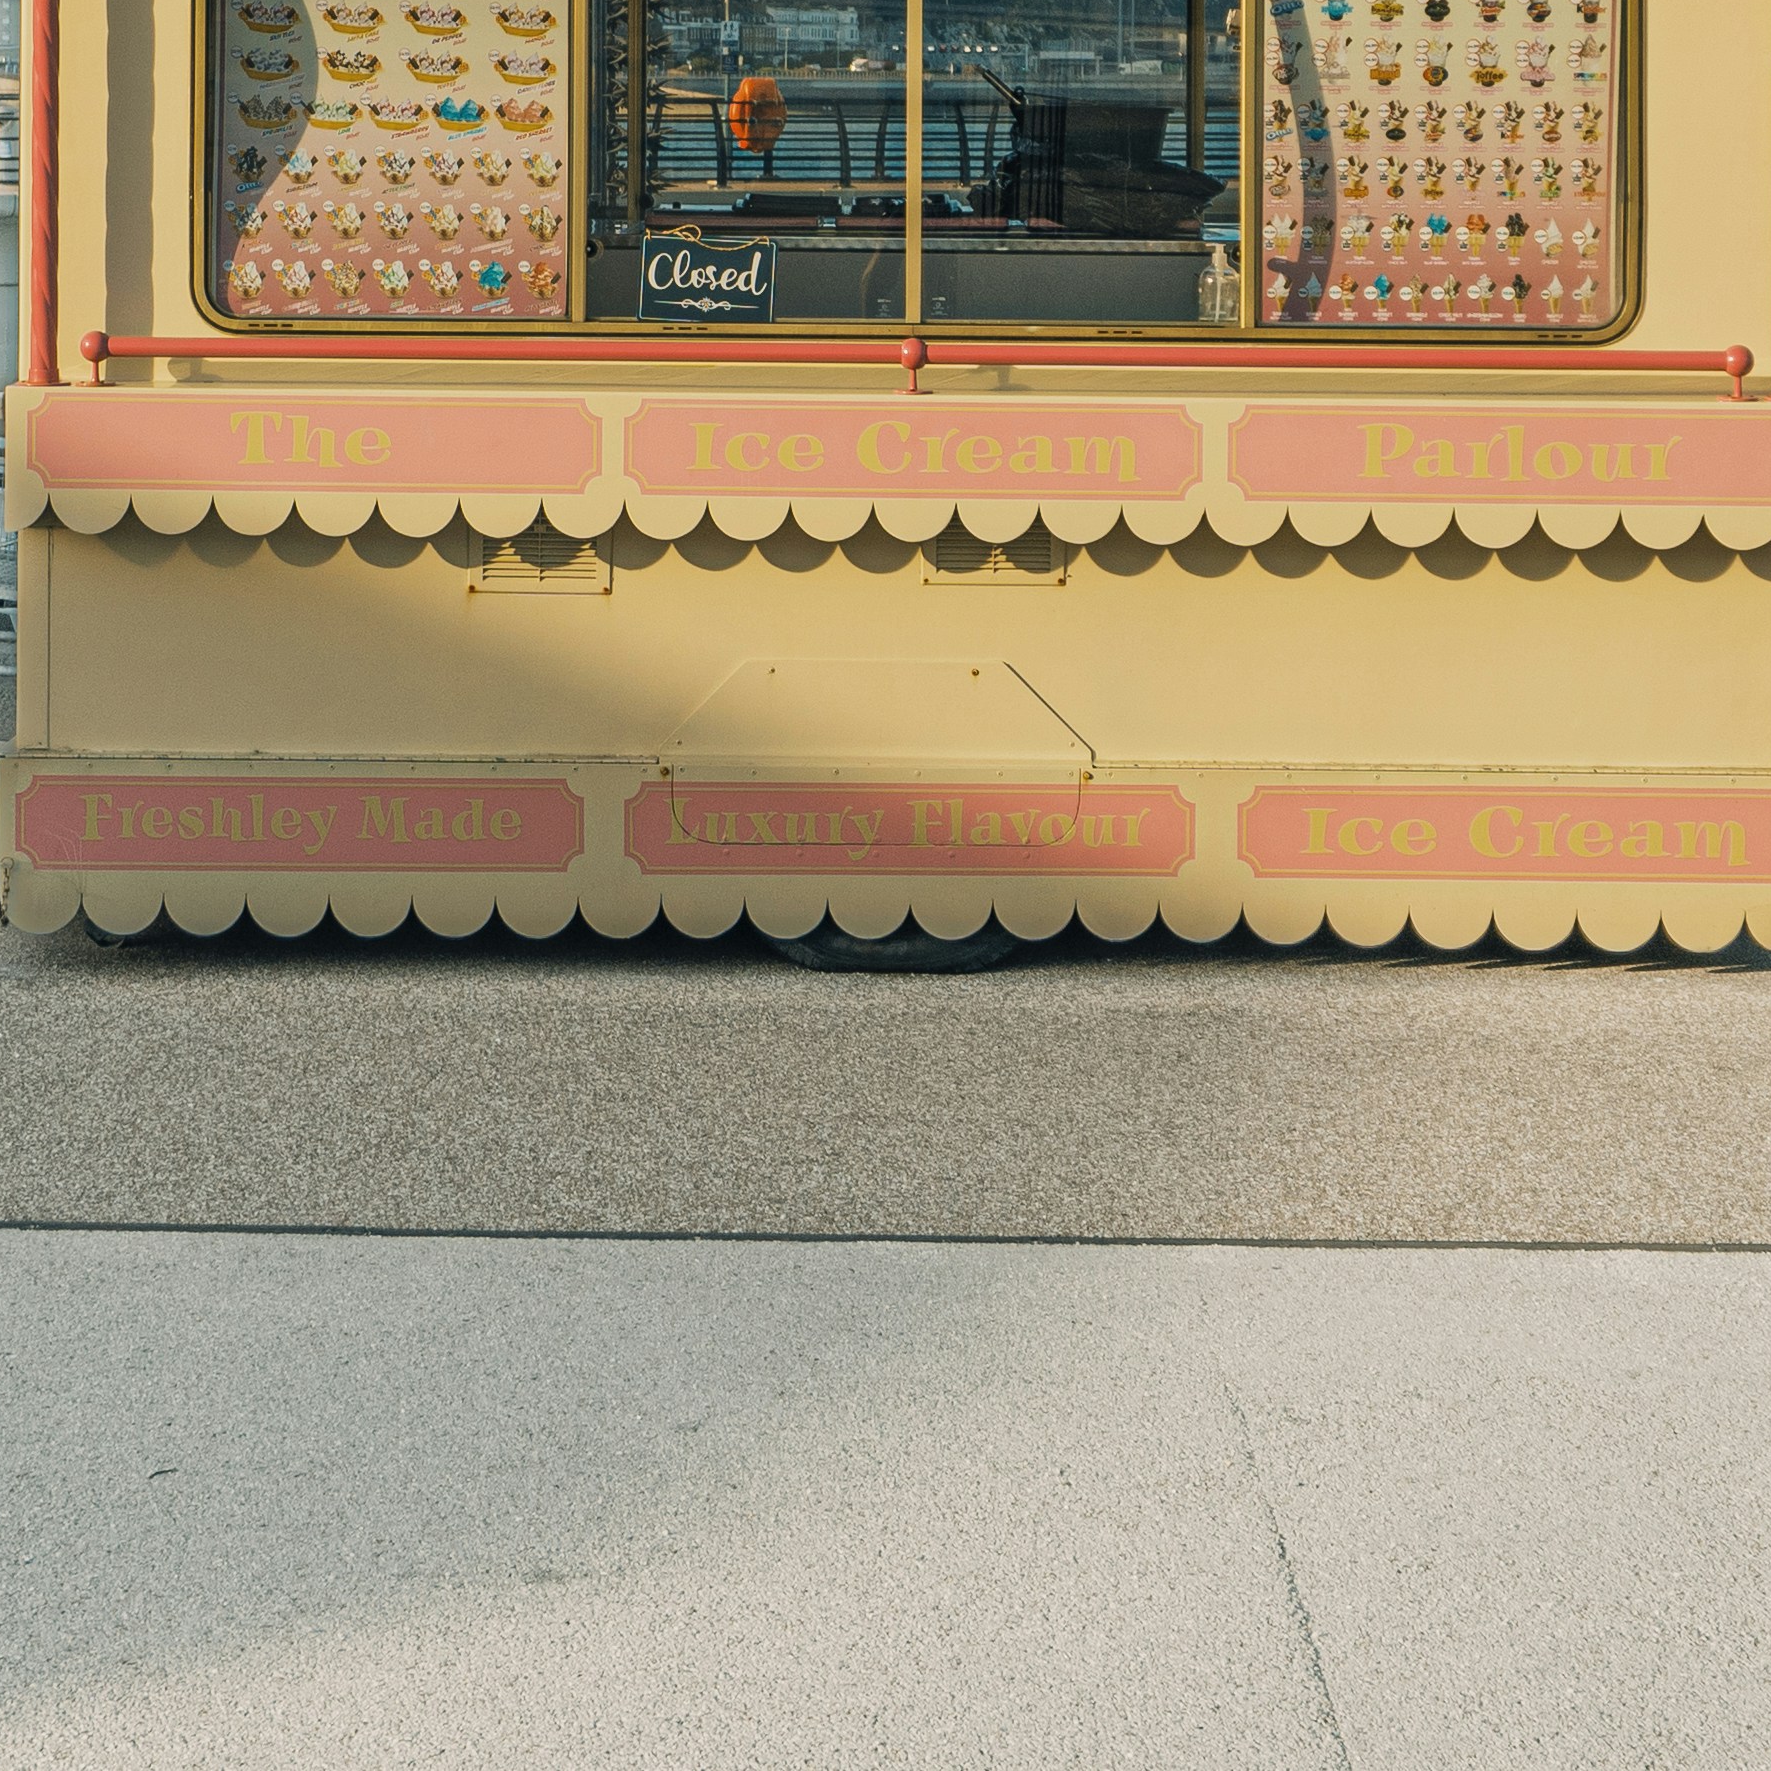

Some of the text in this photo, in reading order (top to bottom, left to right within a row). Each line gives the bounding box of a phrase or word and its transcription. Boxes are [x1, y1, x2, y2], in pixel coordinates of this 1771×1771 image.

[648, 249, 768, 296] Closed
[230, 411, 392, 469] The
[687, 420, 1138, 484] Ice Cream
[1357, 423, 1682, 484] Parlour
[81, 792, 523, 857] Freshley Made
[664, 797, 1151, 861] Luxury Flavour
[1300, 805, 1749, 866] Ice Cream
